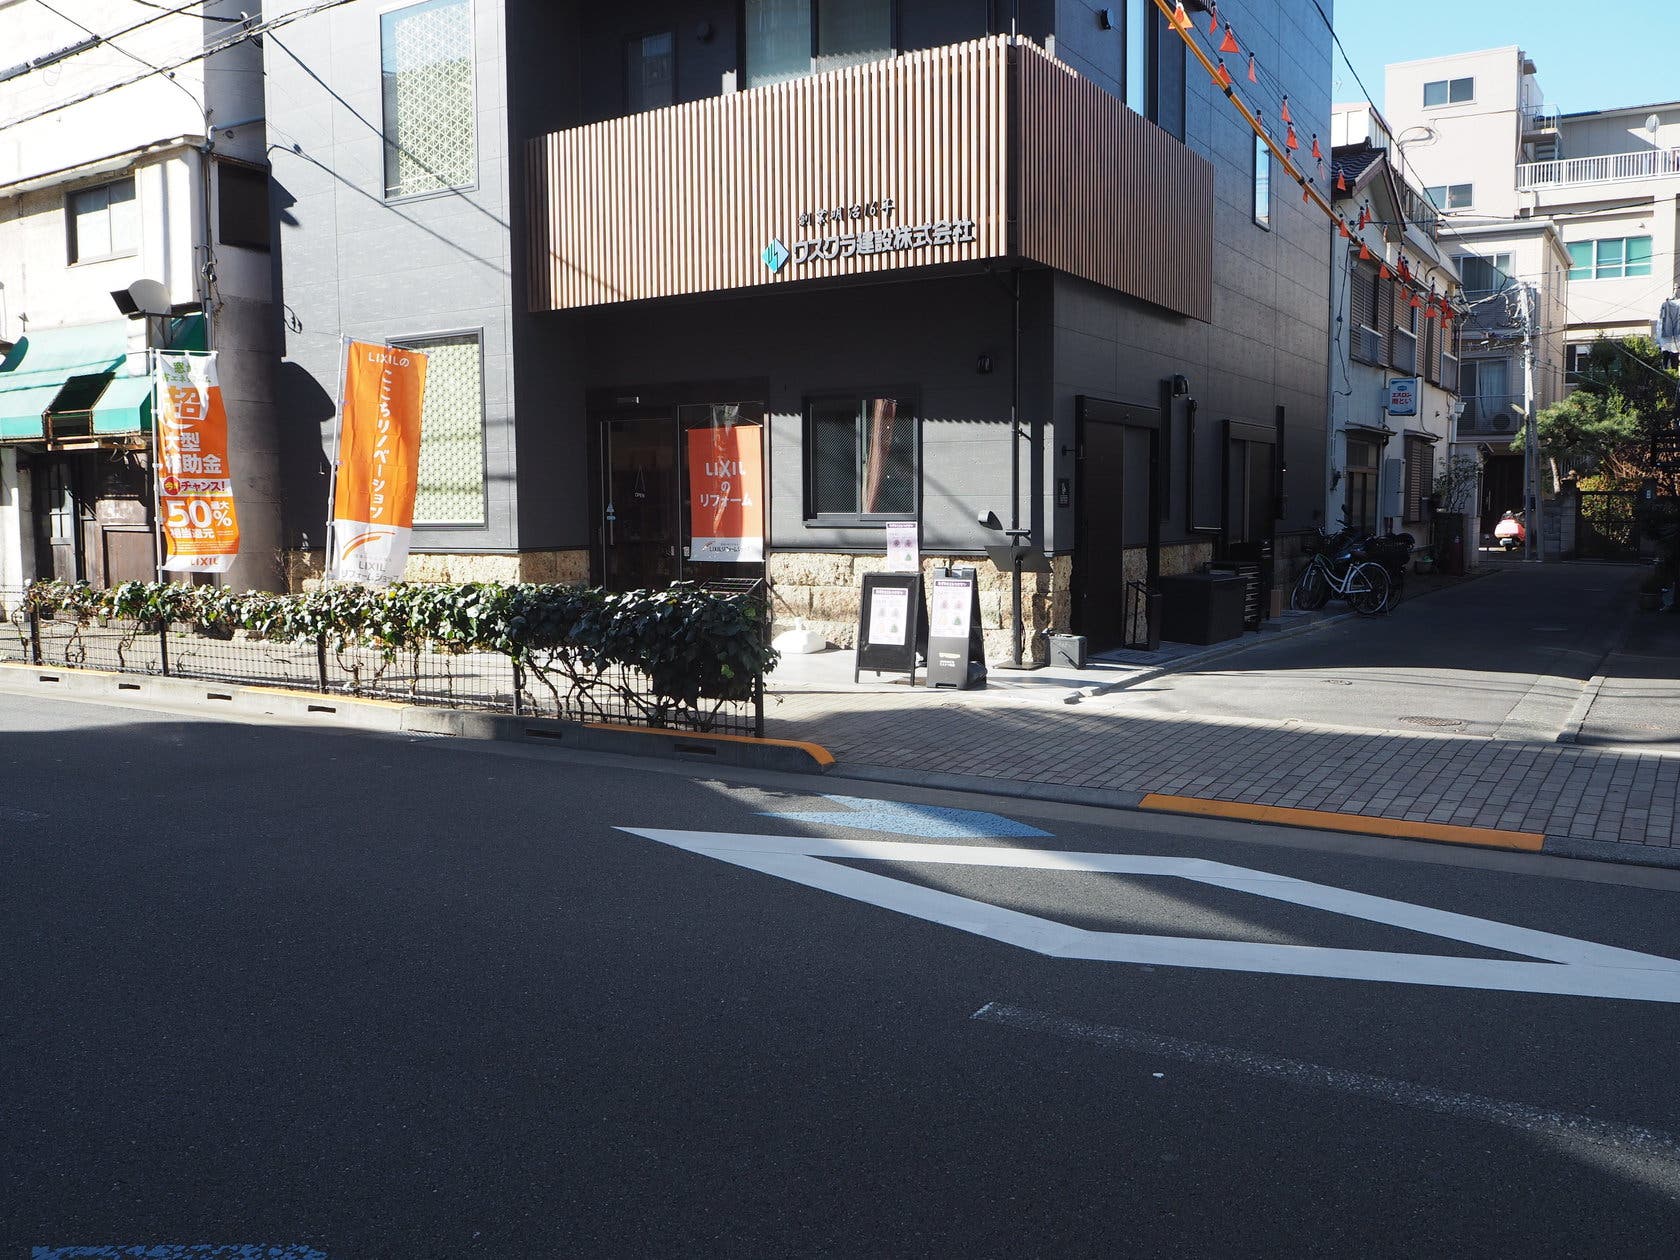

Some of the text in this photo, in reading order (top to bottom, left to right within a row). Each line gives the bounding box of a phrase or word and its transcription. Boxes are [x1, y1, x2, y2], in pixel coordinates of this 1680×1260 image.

[368, 351, 410, 368] LIXILの
[165, 432, 201, 452] 大型
[370, 368, 392, 519] ここちリノベーション
[705, 459, 747, 478] LIXIL
[721, 481, 731, 494] の
[700, 492, 753, 507] リフォーム
[359, 560, 386, 573] LIXIL
